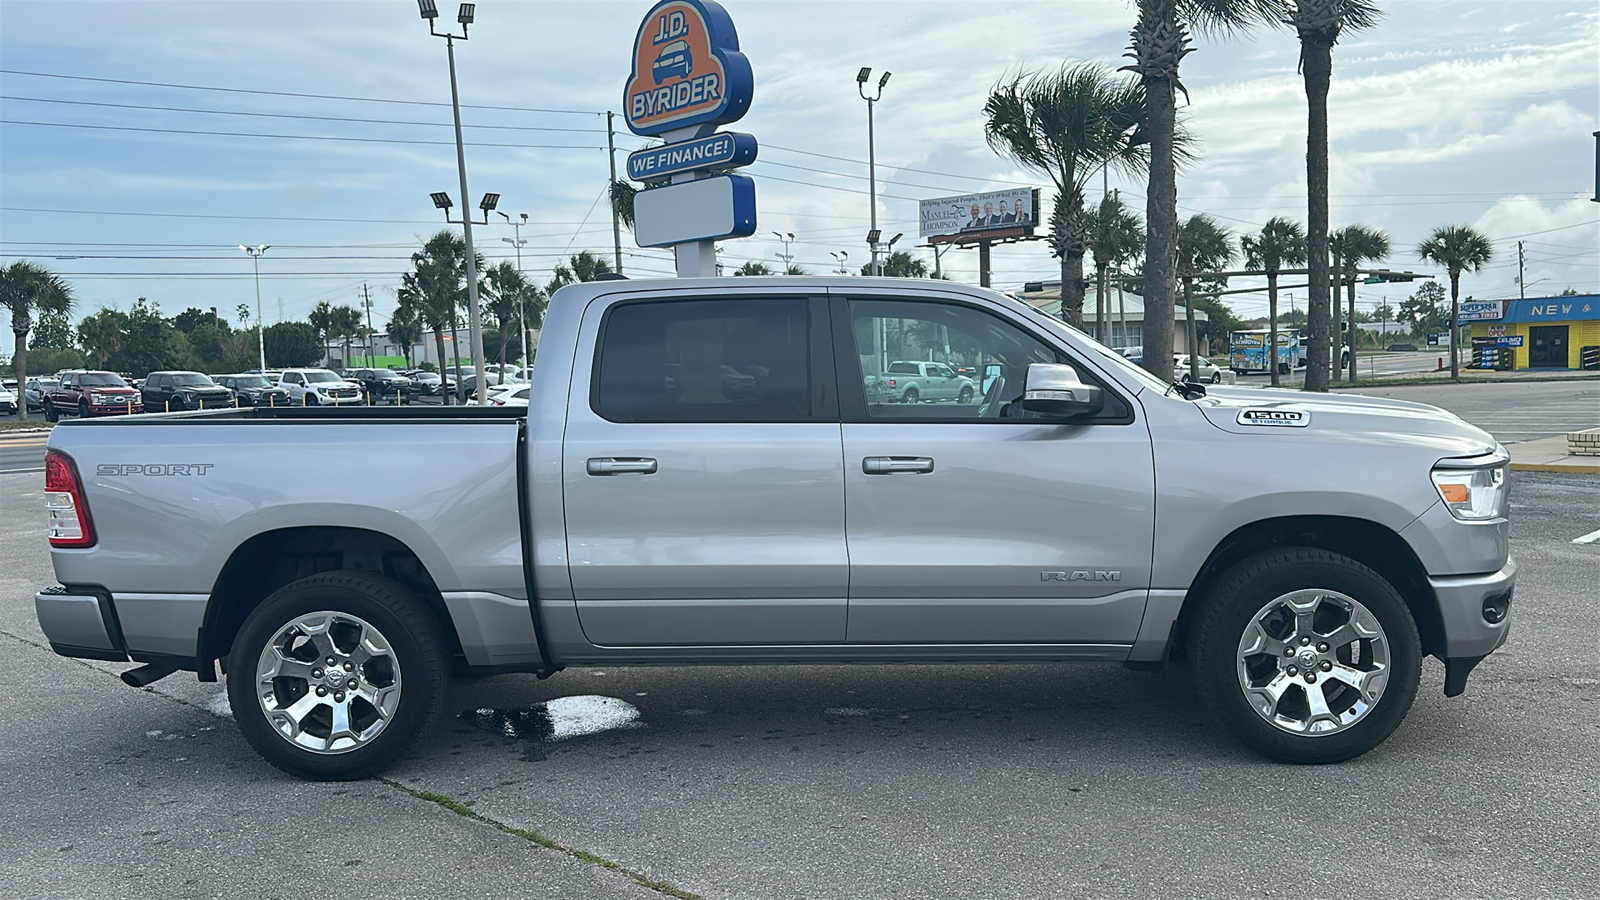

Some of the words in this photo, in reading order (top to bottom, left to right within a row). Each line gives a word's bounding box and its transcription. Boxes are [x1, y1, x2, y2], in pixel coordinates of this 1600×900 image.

[653, 11, 689, 44] J.D.
[632, 73, 721, 120] BYRIDER
[632, 155, 655, 173] WE
[658, 140, 729, 169] FINANCE!
[922, 220, 958, 231] THOMPSON
[1460, 304, 1479, 312] SUPER
[1480, 302, 1497, 312] STAR
[1531, 304, 1573, 316] NEW
[1582, 303, 1592, 313] &
[1488, 329, 1506, 337] OPEN
[1248, 411, 1301, 420] 1500
[96, 464, 214, 476] SPORT
[1041, 571, 1121, 581] RAM
